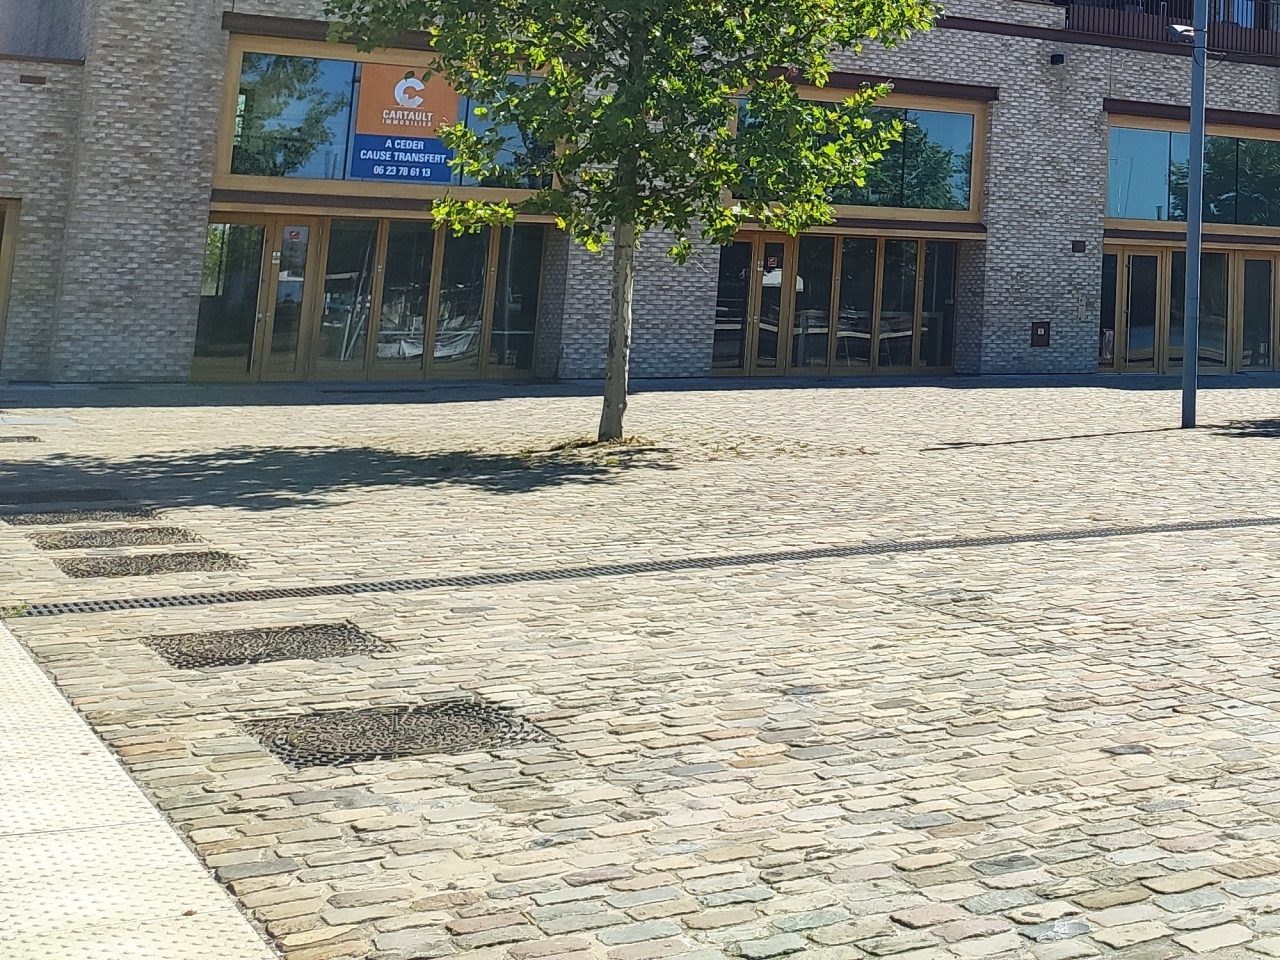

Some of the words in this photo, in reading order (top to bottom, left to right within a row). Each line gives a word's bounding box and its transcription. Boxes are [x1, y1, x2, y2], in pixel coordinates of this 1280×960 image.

[383, 110, 433, 121] CARTAULT
[382, 119, 432, 127] IMMOBILIER
[385, 139, 392, 148] A
[394, 139, 424, 150] CEDER
[360, 150, 391, 160] CAUSE
[394, 152, 446, 163] TRANSFERT
[373, 165, 384, 174] 06
[386, 166, 396, 175] 23
[410, 167, 419, 176] 61
[421, 168, 431, 177] 13
